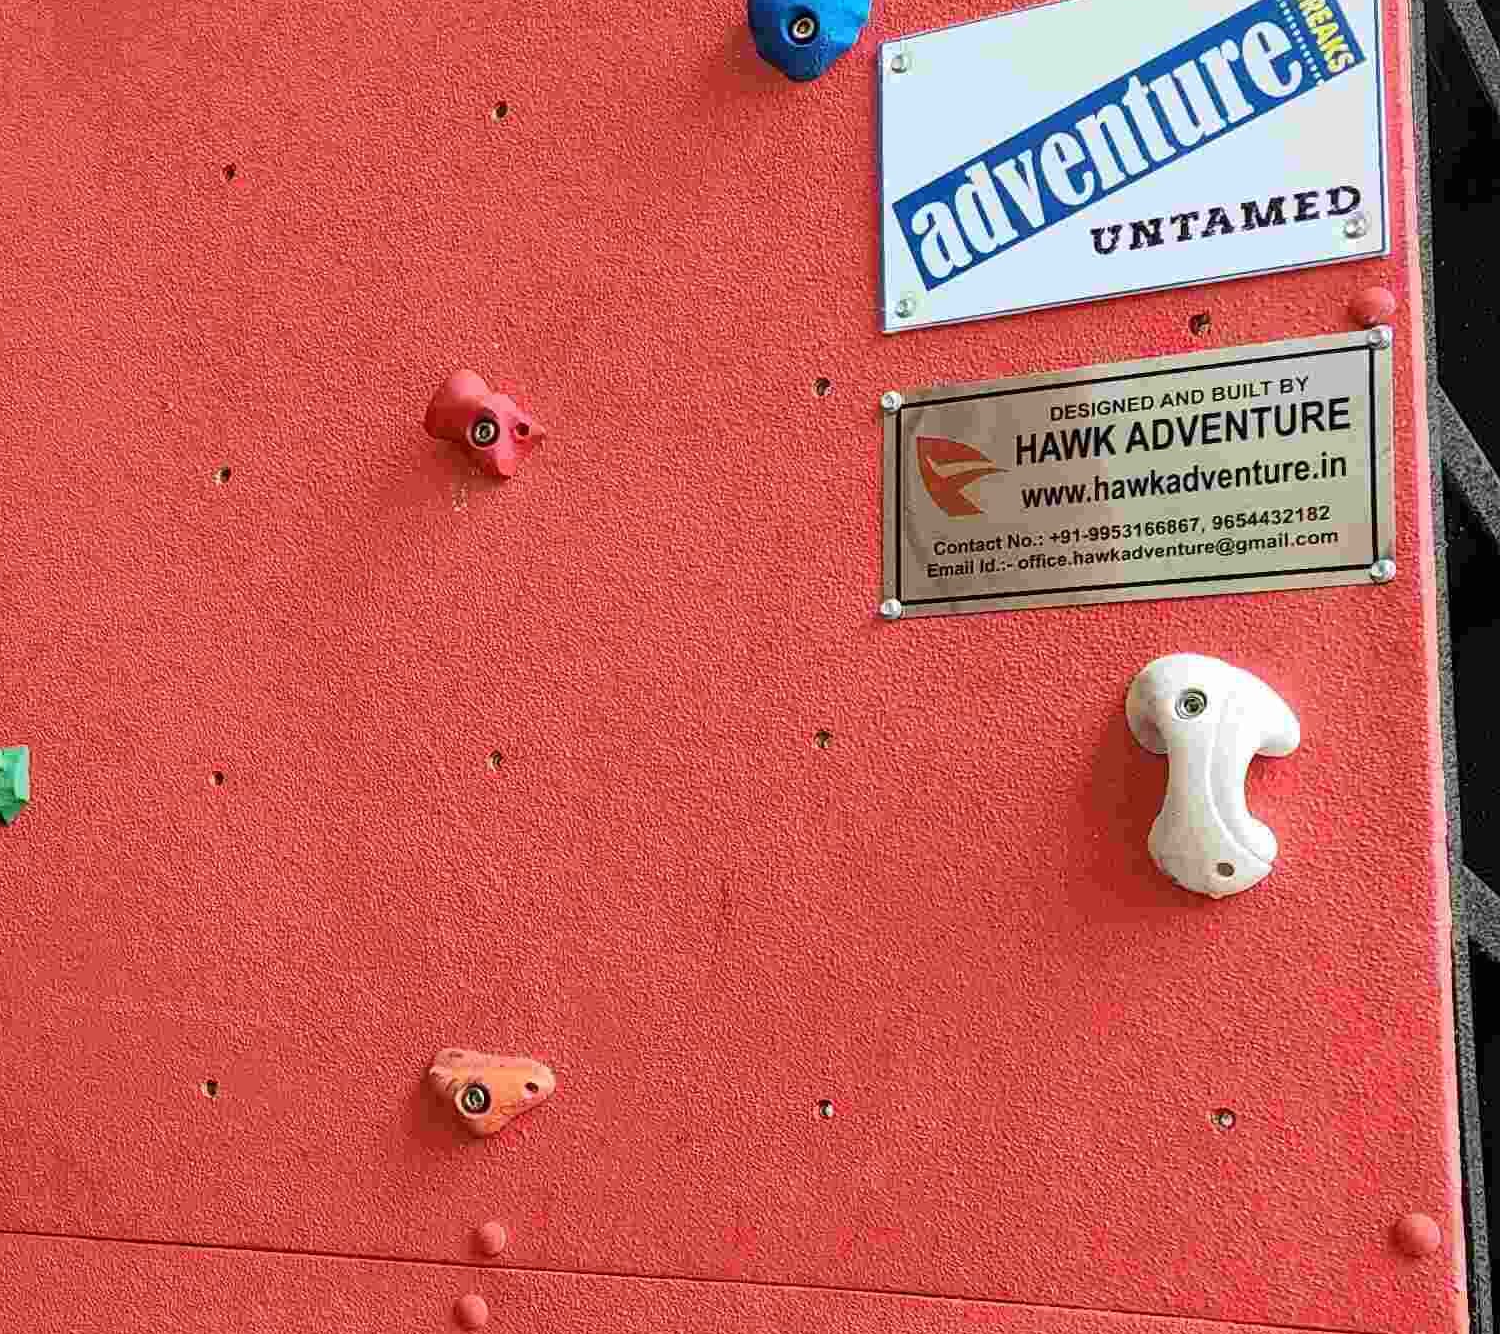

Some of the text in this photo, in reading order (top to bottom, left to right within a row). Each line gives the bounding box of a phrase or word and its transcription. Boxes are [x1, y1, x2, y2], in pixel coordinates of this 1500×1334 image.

[911, 20, 1303, 280] adventure
[1091, 185, 1361, 255] UNTAMED
[1050, 376, 1309, 421] DESIGNED AND BUILT BY
[1016, 397, 1351, 466] HAWK ADVENTURE
[1021, 451, 1348, 509] www.hawkadventure.in
[927, 560, 974, 578] Email
[1017, 530, 1340, 571] office.hawkadventure@gmail.com
[933, 505, 1331, 556] Contact No.: +91-9953166867, 9654432182
